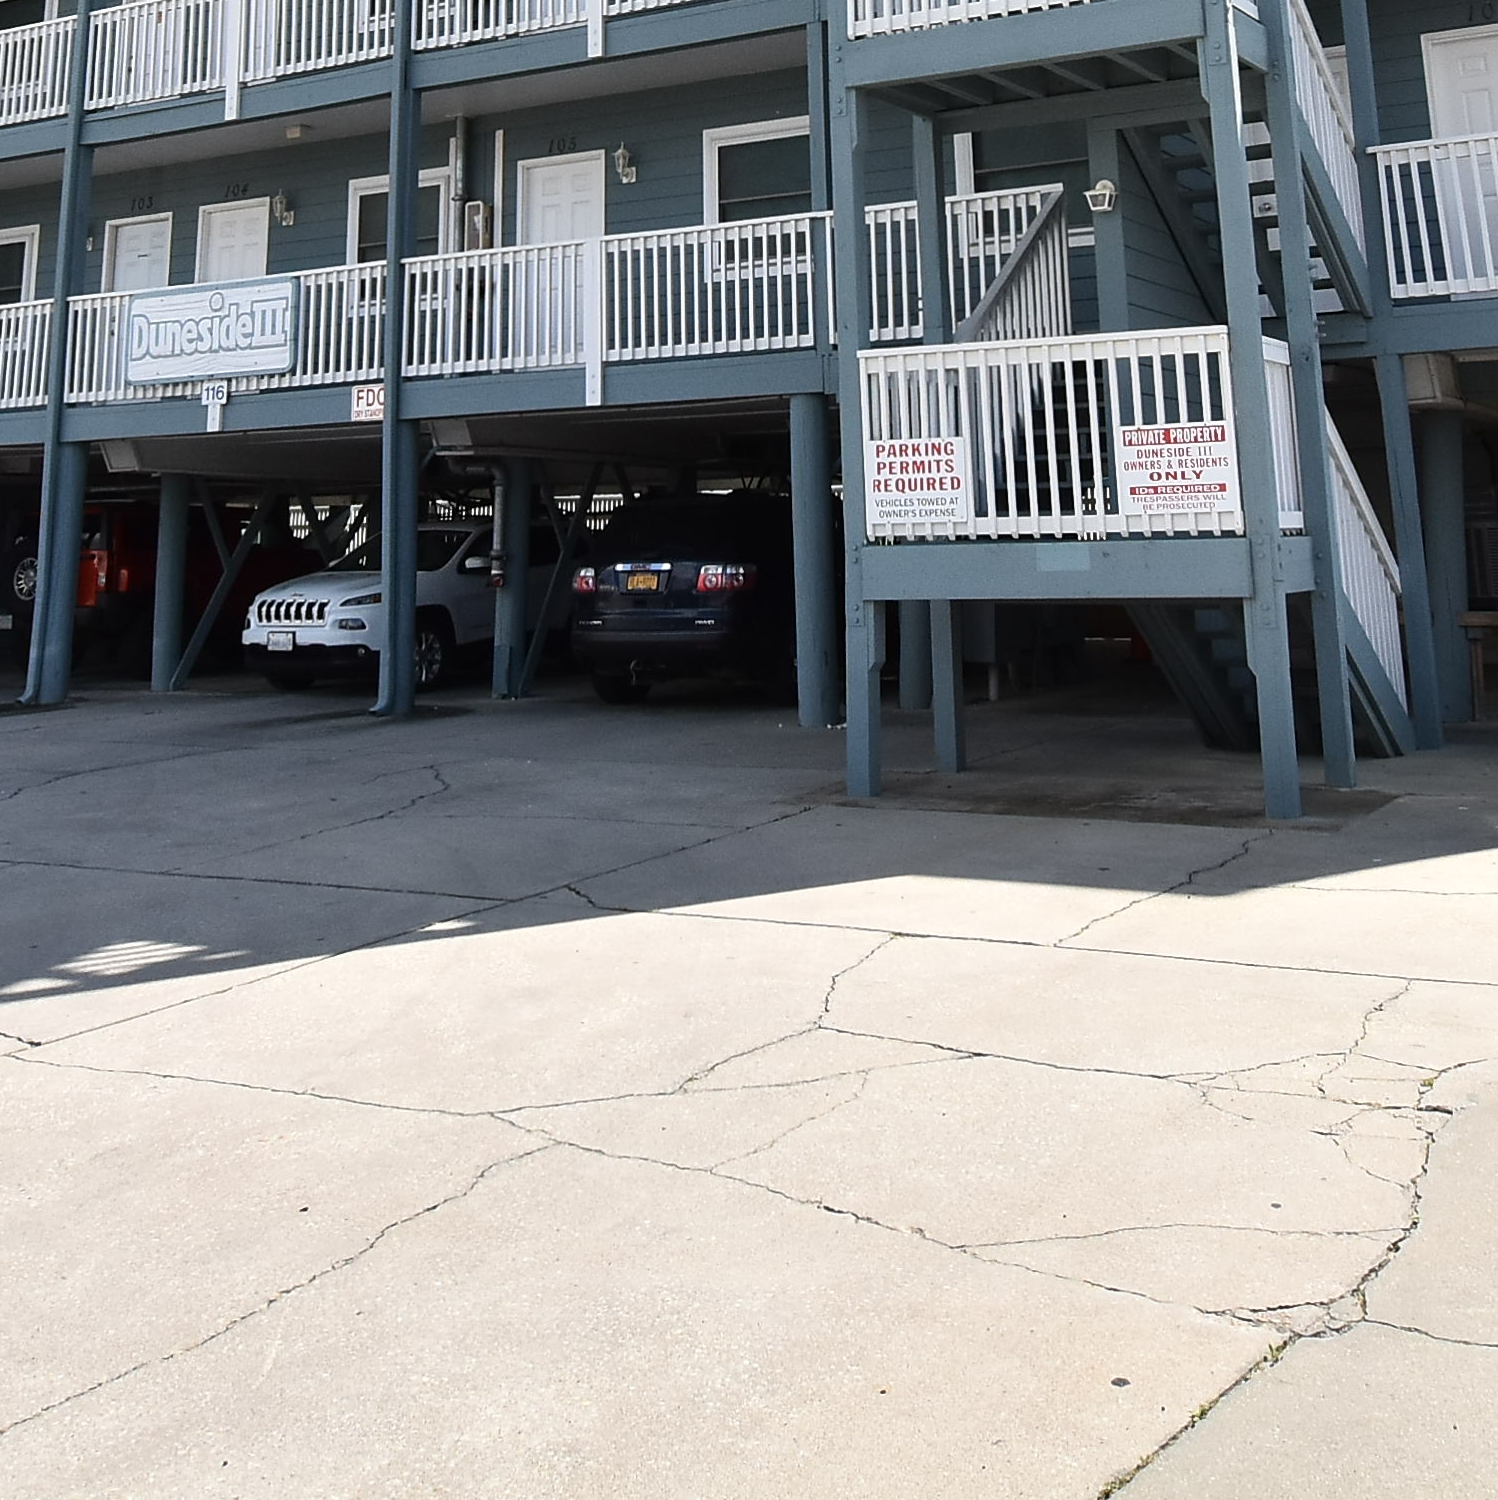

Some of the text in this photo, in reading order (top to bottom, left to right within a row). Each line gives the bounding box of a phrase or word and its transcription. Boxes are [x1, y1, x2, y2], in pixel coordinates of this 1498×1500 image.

[130, 292, 252, 361] Duneside
[204, 385, 225, 401] 116
[1124, 426, 1222, 446] PRIVATE PROPERTY
[875, 441, 955, 459] PARKING
[1136, 446, 1193, 459] DUNESIDE
[876, 459, 955, 476] PERMITS
[1123, 457, 1229, 471] OWNERS & RESIDENTS
[1148, 470, 1204, 482] ONLY
[872, 476, 961, 494] REQUIRED
[1135, 484, 1221, 495] IDs REQUIRED
[874, 497, 959, 508] VEHICLES TOWED AT
[1132, 493, 1227, 503] TRESPASSERS WILL
[1142, 501, 1216, 511] BE PROSECUTED
[878, 508, 957, 519] OWNER'S EXPENSE
